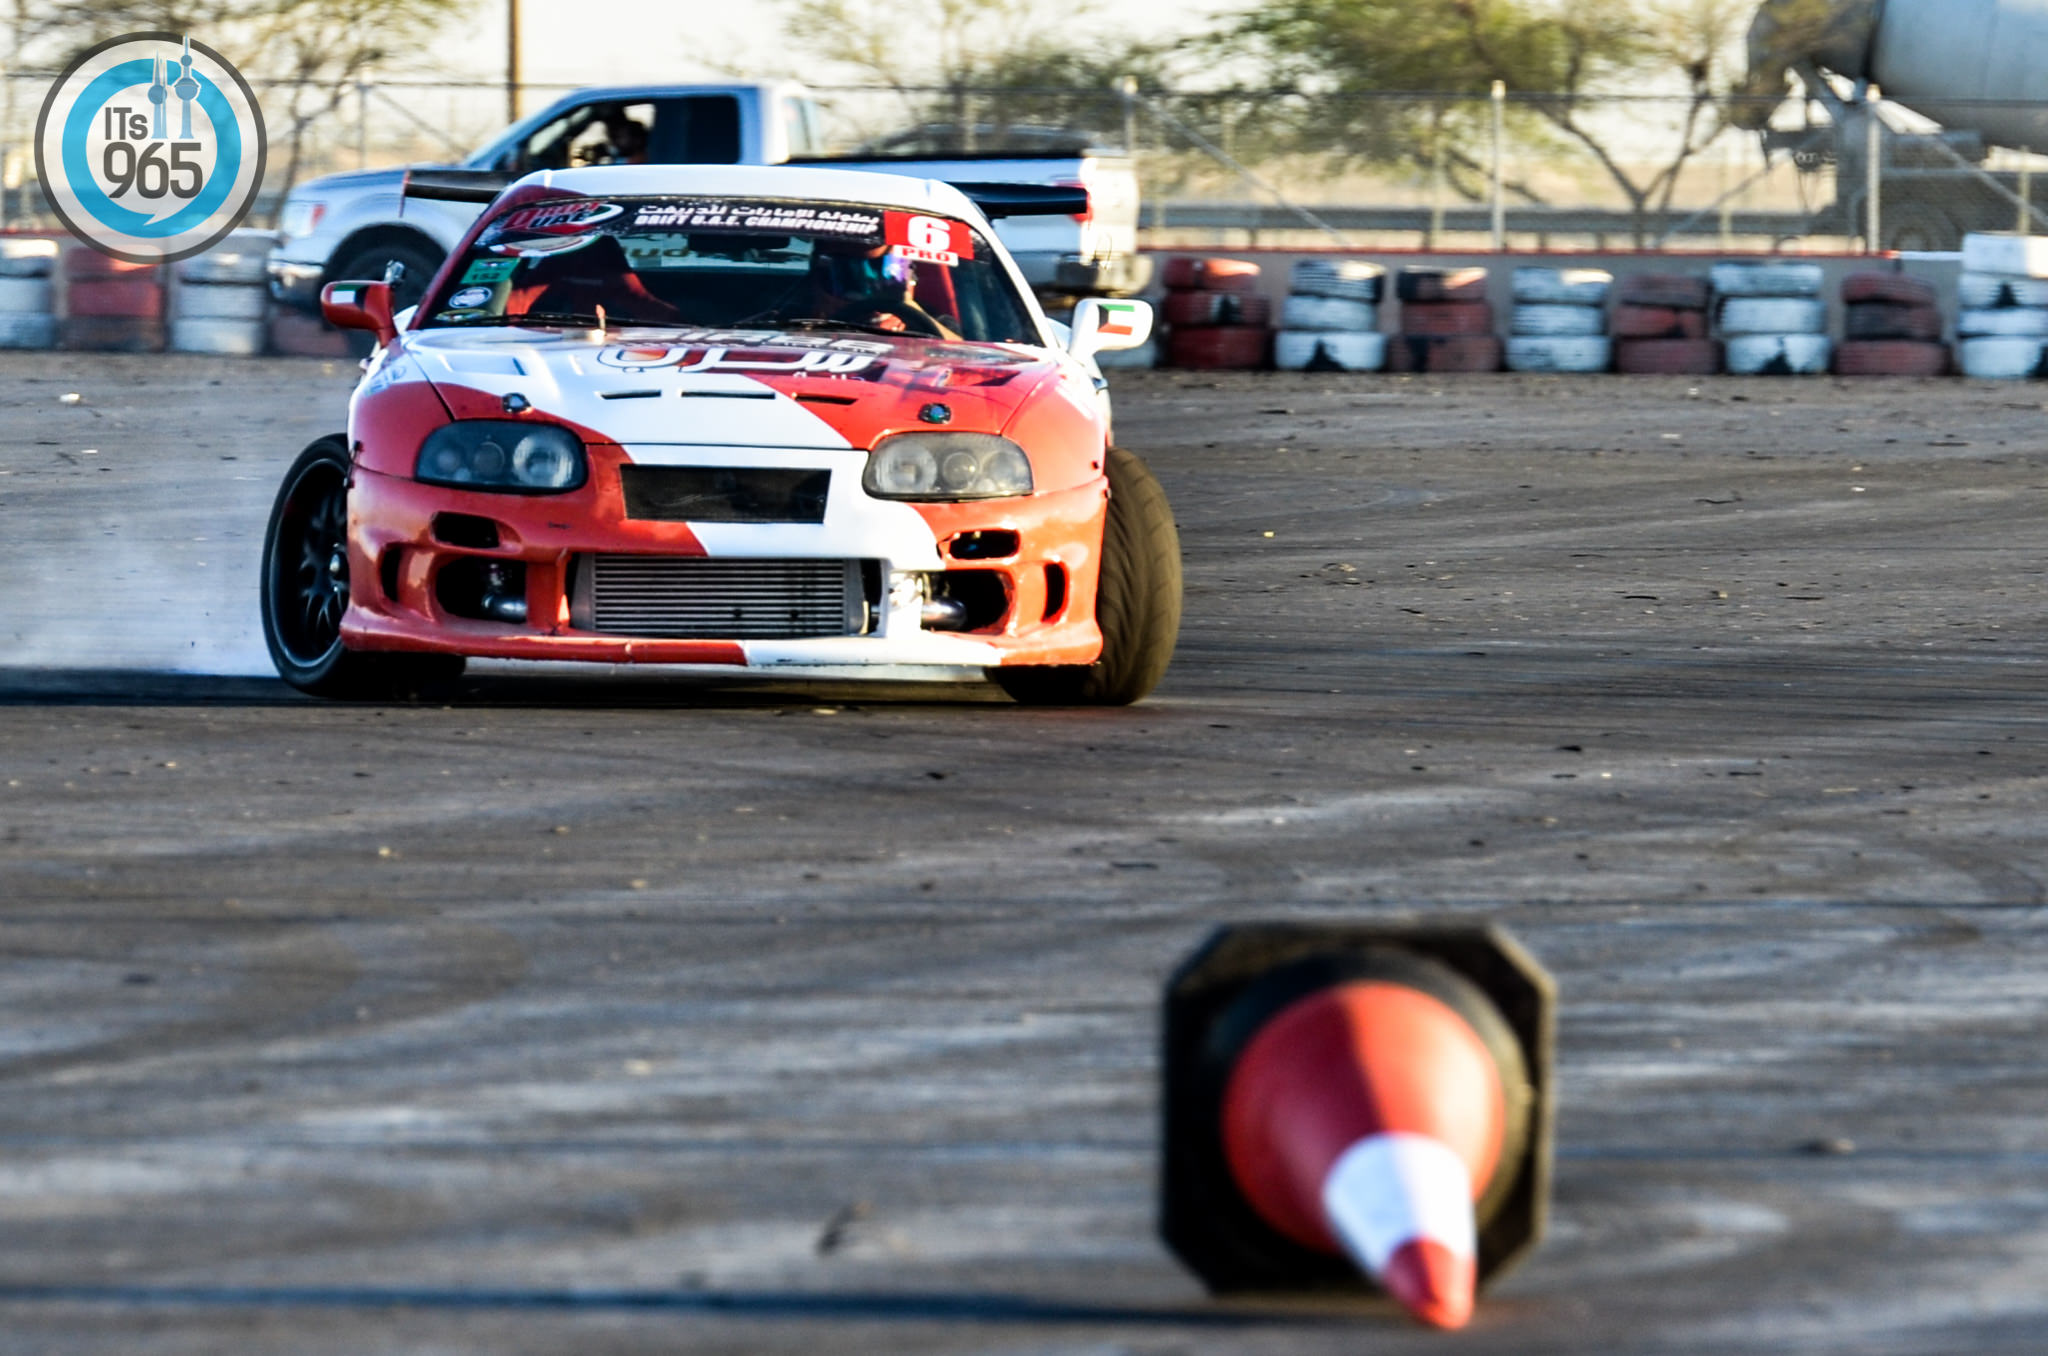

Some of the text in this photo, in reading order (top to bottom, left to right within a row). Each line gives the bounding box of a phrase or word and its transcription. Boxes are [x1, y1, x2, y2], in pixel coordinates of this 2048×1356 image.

[528, 212, 591, 228] UAE
[634, 214, 690, 226] DRIFT
[744, 216, 878, 234] CHAMPIONSHIP
[908, 215, 950, 252] 6
[901, 247, 950, 262] PRO
